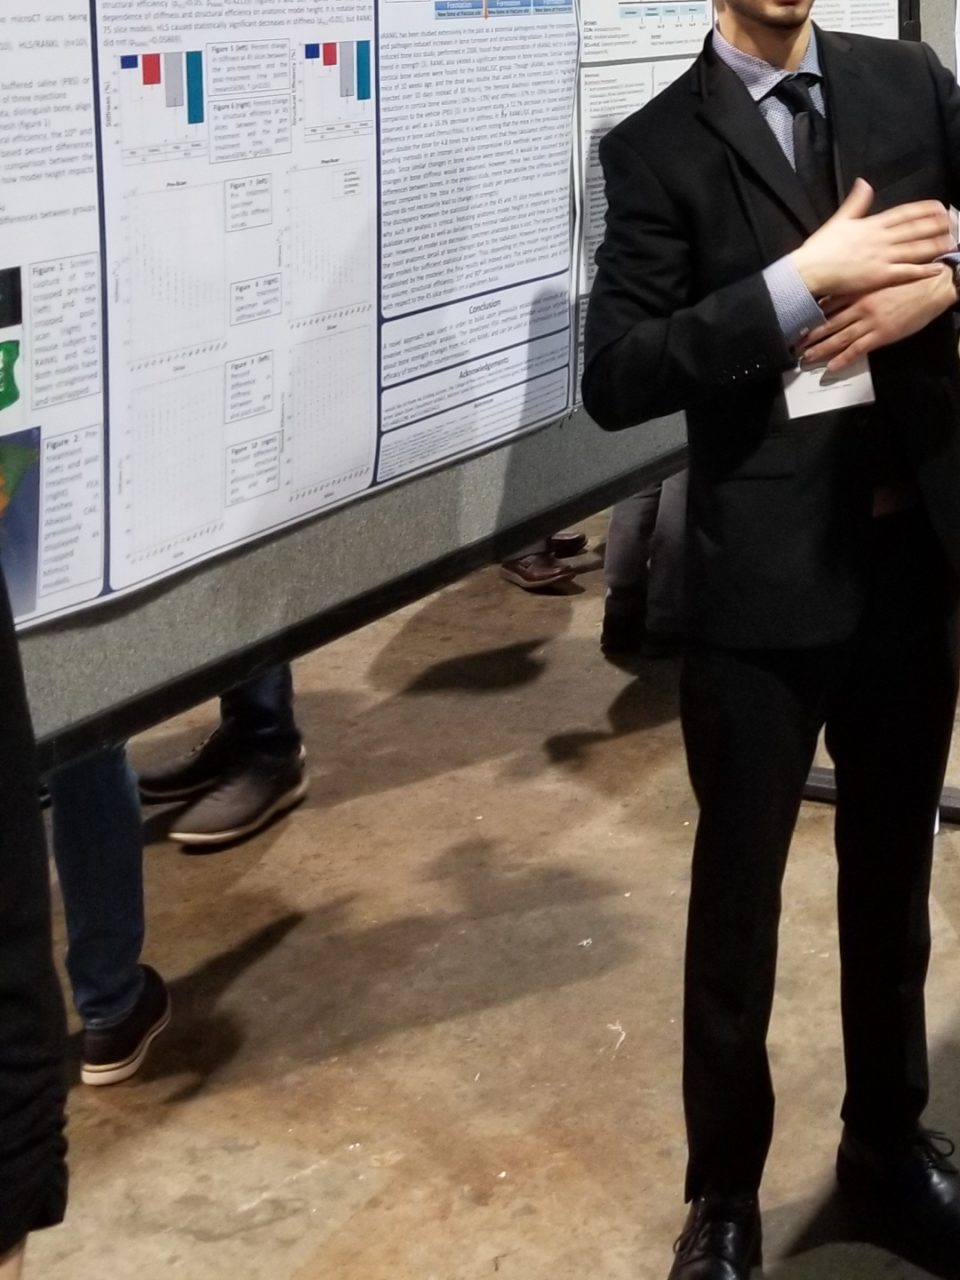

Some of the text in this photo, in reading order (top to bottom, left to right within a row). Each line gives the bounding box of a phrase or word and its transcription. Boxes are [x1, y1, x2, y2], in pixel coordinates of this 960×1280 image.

[212, 46, 228, 54] Figure
[32, 265, 55, 276] Figure
[469, 299, 501, 315] Conclusion
[46, 438, 69, 450] Figure
